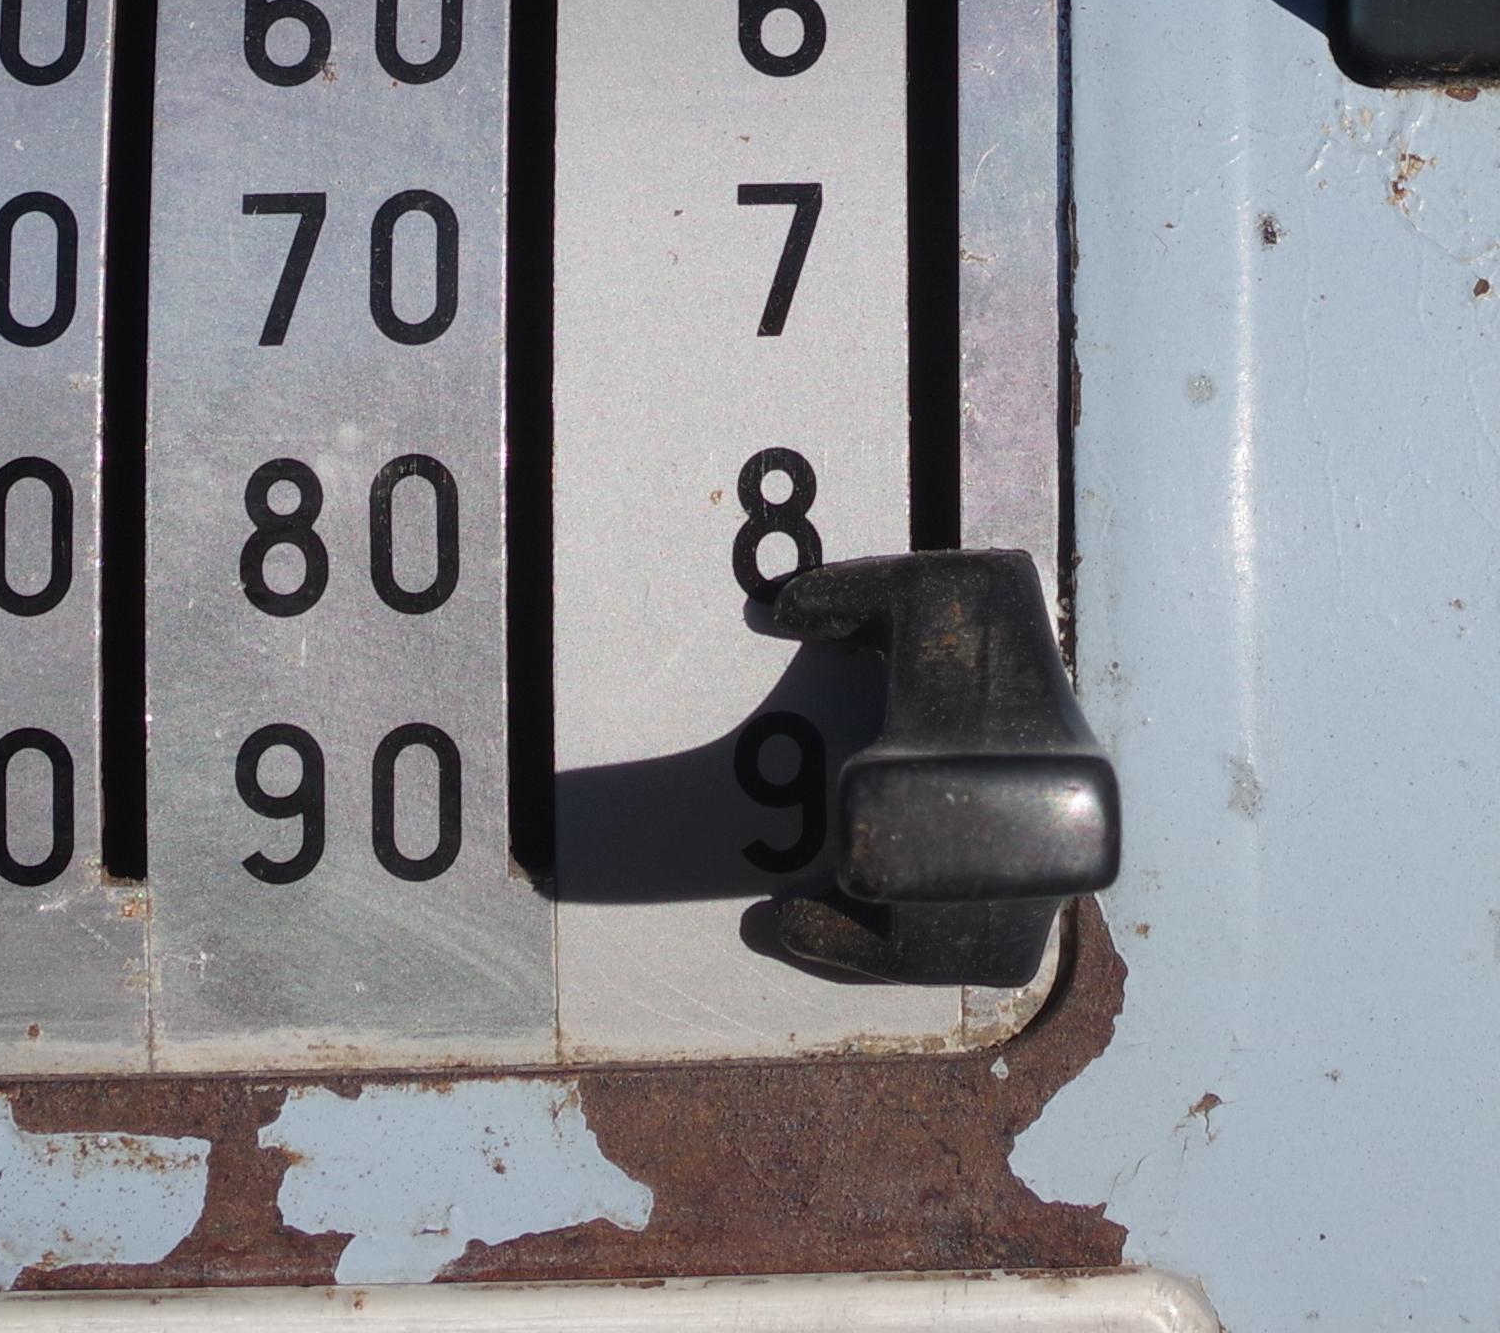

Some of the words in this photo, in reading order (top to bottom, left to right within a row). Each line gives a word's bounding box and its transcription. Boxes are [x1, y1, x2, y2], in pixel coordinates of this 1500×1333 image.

[242, 189, 459, 346] 70
[738, 183, 822, 336] 7
[240, 454, 459, 617] 80
[733, 447, 822, 604] 8
[235, 723, 462, 885] 90
[734, 711, 827, 873] 9
